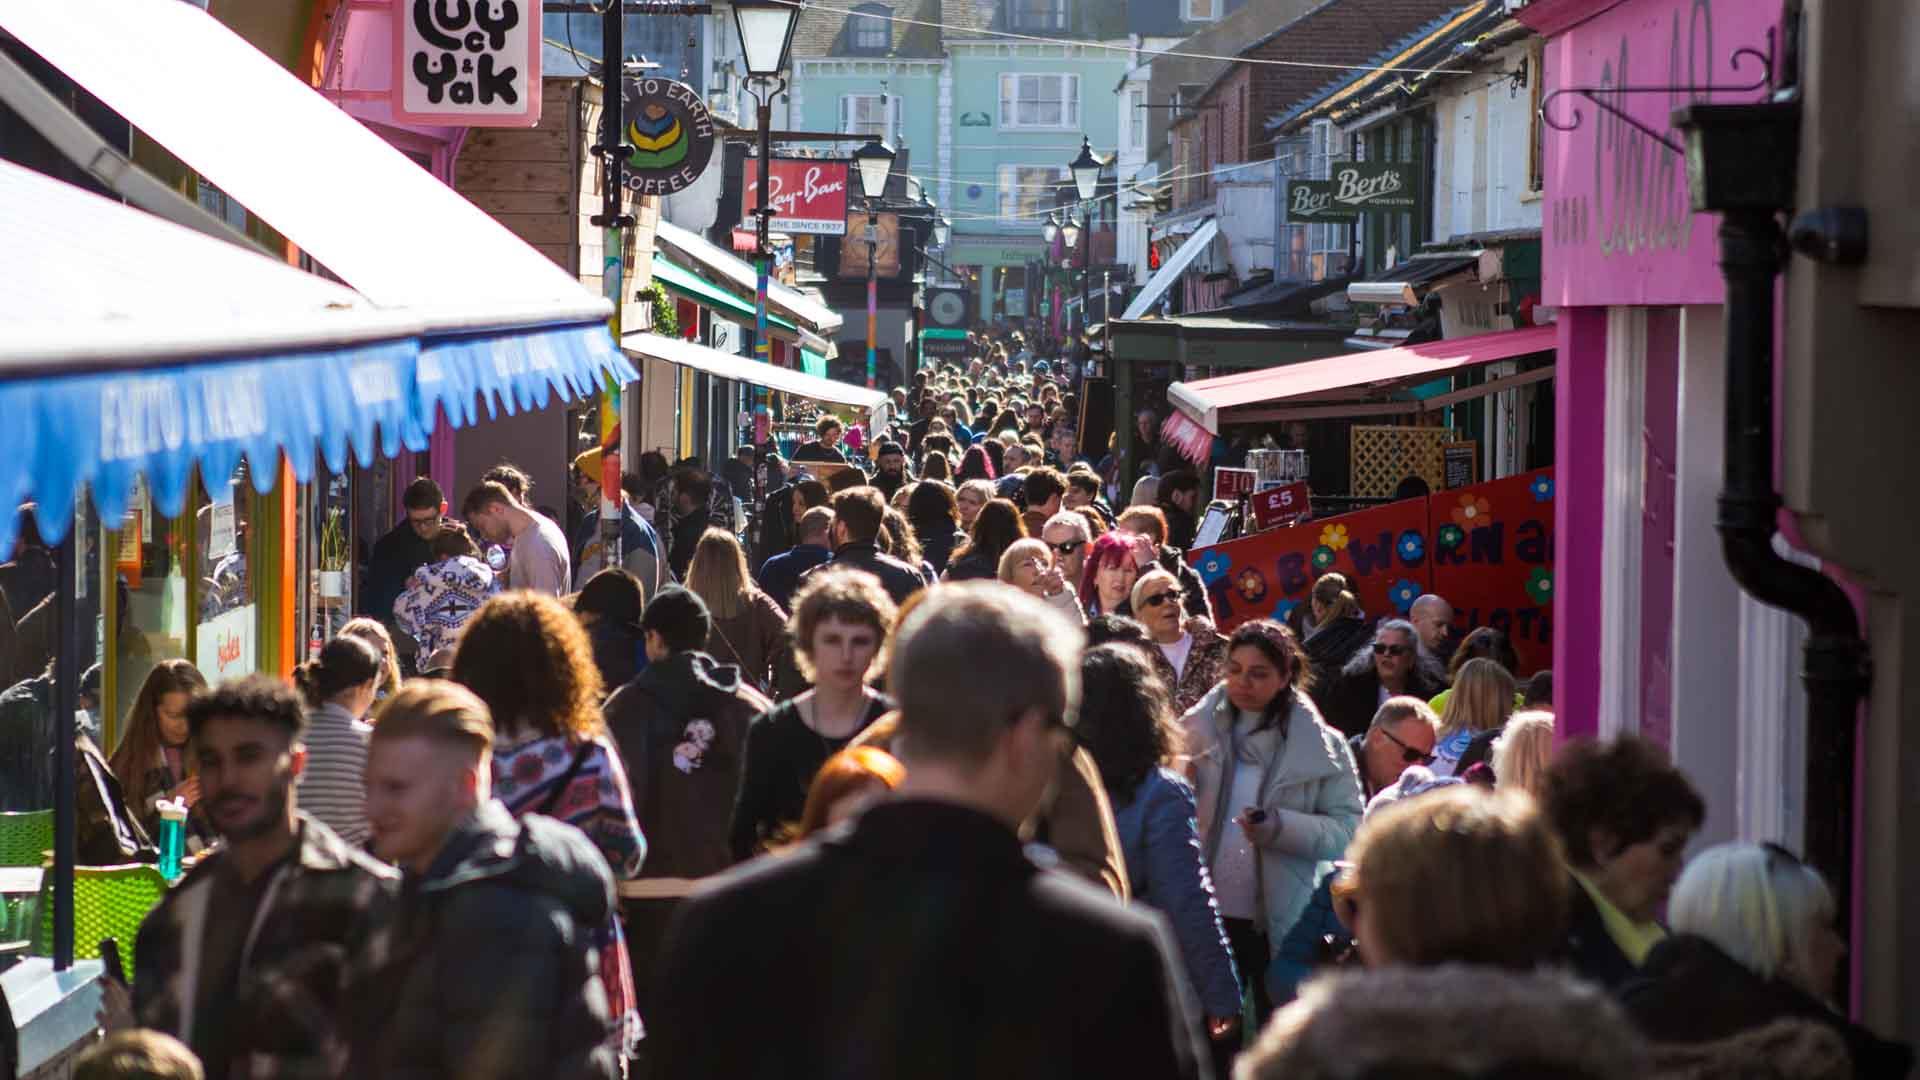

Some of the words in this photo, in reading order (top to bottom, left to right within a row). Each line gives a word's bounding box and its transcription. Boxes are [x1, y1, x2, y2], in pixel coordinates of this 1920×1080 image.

[633, 80, 659, 97] TO
[666, 82, 713, 139] EARTH
[748, 167, 843, 215] Ray-Ban
[1289, 186, 1332, 215] Ber
[1268, 489, 1293, 509] £5
